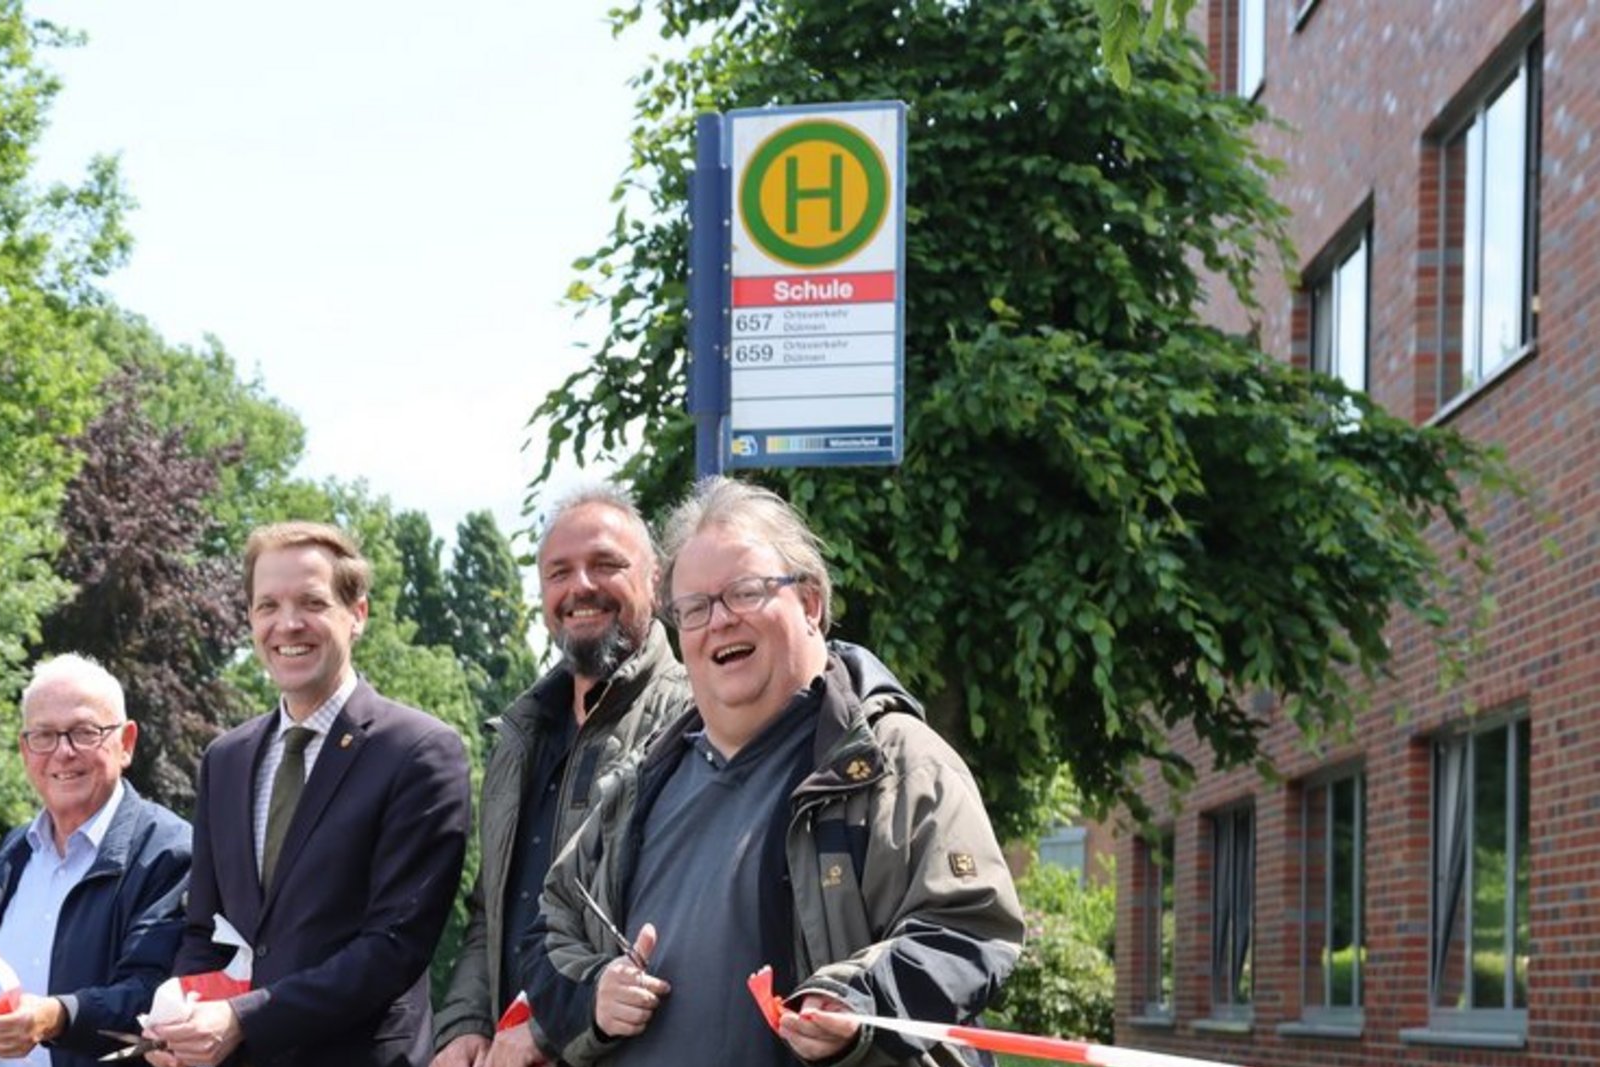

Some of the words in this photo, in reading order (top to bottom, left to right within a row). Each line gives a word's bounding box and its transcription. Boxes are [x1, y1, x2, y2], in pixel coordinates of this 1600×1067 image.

[785, 154, 843, 234] H
[773, 278, 854, 301] Schule
[735, 314, 773, 332] 657
[735, 344, 774, 362] 659
